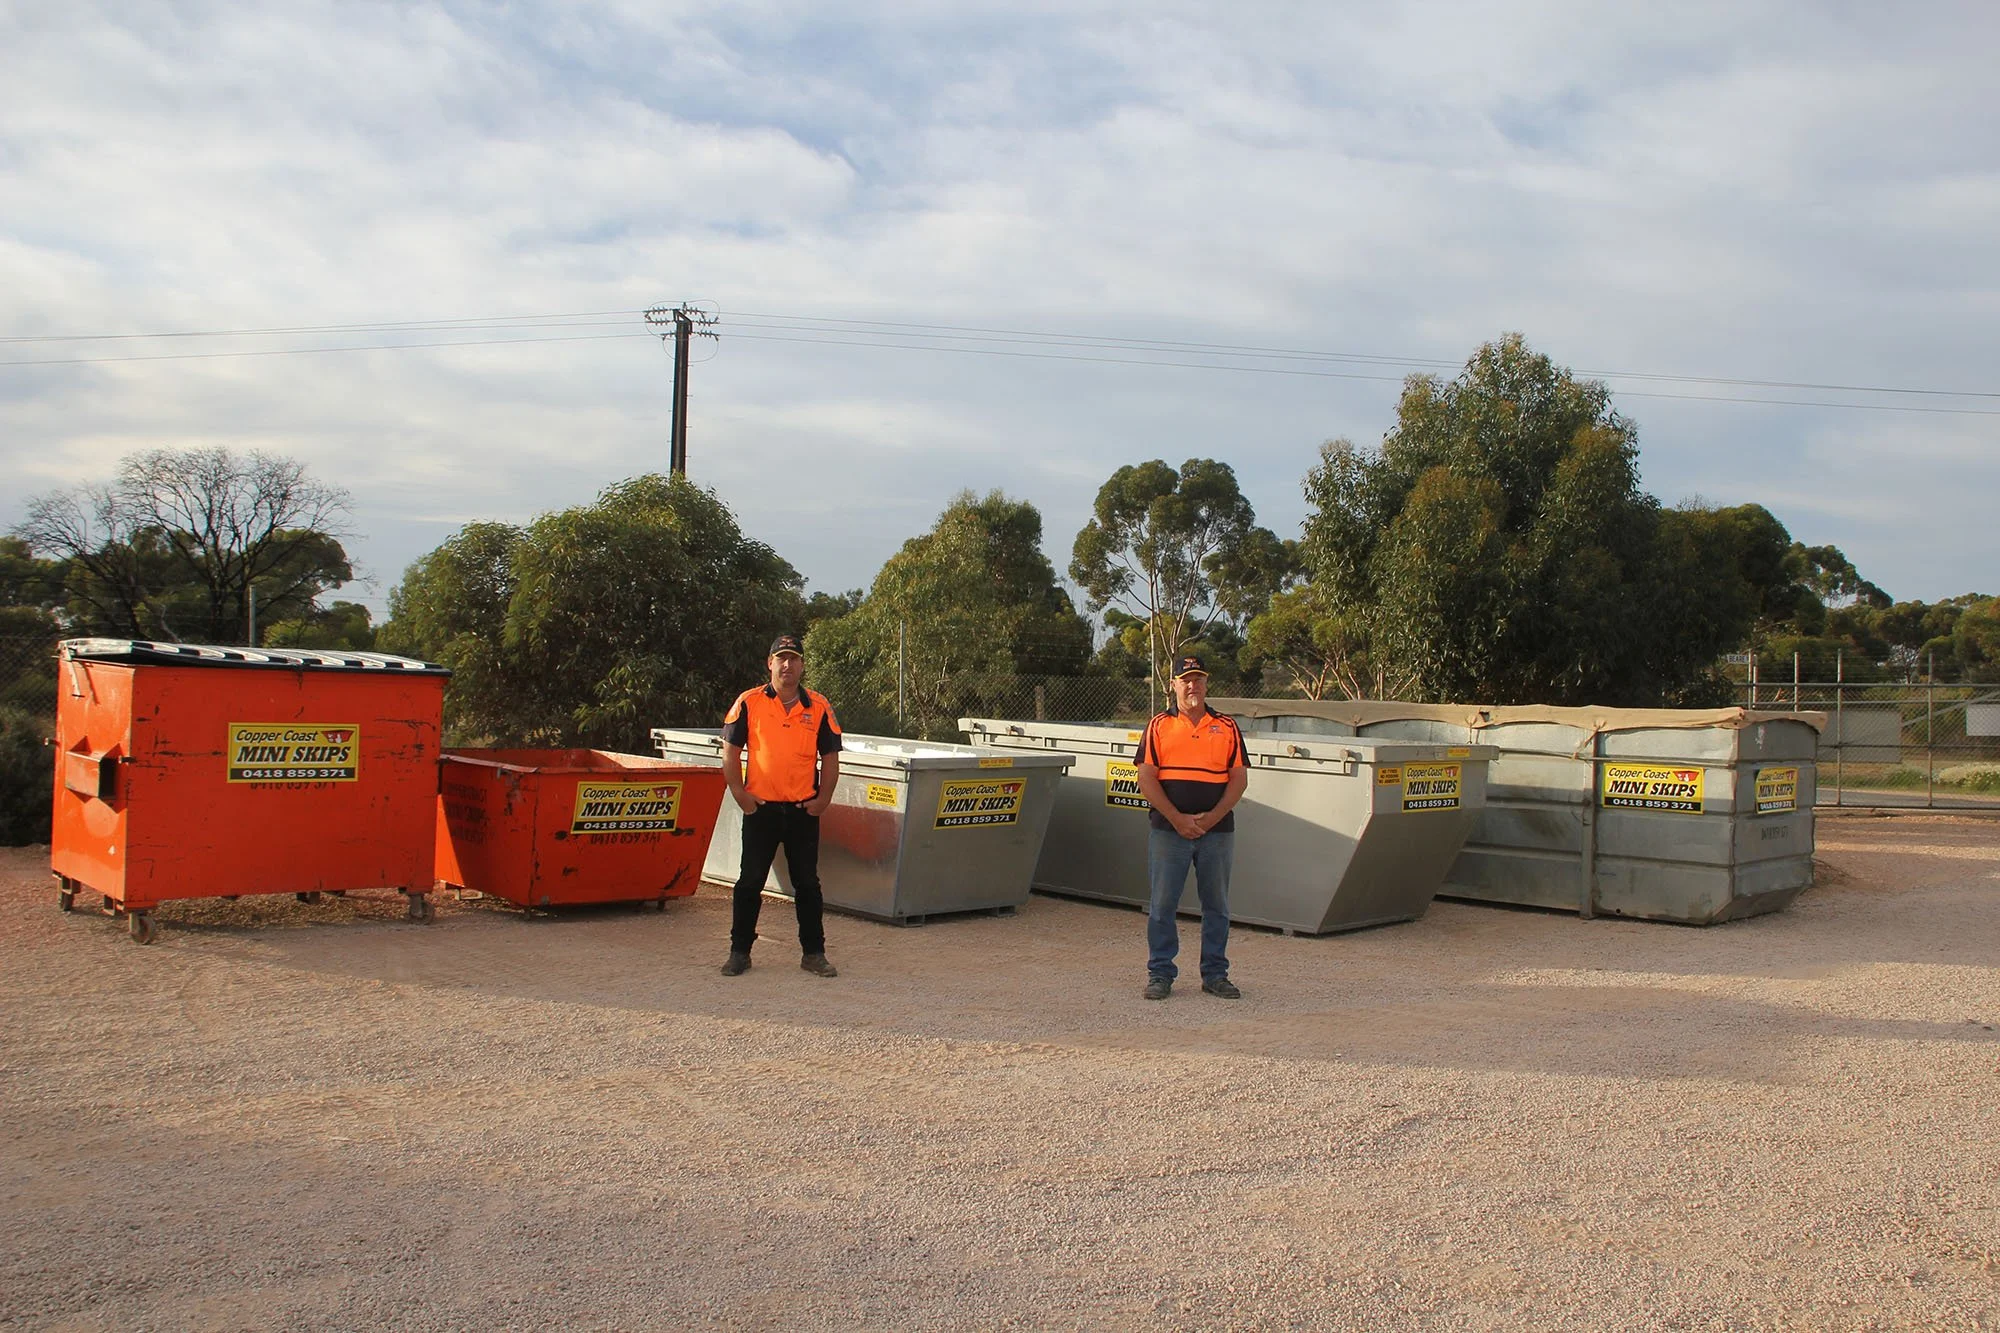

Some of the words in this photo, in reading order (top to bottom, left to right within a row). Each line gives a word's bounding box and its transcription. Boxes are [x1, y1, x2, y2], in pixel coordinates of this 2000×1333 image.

[236, 730, 281, 743] Copper
[283, 730, 318, 741] Coast
[237, 746, 290, 762] MINI
[292, 746, 351, 762] SKIPS
[242, 769, 283, 778] 0418
[287, 769, 316, 778] 859
[320, 769, 347, 777] 371
[1110, 766, 1138, 777] Copper
[1407, 768, 1427, 780] Copper
[1428, 767, 1443, 777] Coast
[1608, 768, 1641, 779] Copper
[1643, 769, 1670, 780] Coast
[582, 788, 620, 800] Copper
[621, 788, 650, 798] Coast
[946, 785, 975, 798] Copper
[976, 784, 1000, 795] Coast
[1407, 781, 1430, 796] MINI
[1432, 780, 1457, 794] SKIPS
[1609, 780, 1648, 795] MINI
[1650, 782, 1697, 797] SKIPS
[943, 798, 979, 813] MINI
[977, 796, 1018, 811] SKIPS
[1114, 797, 1139, 806] 0418
[1613, 798, 1643, 806] 0418
[1645, 800, 1669, 808] 859
[1671, 801, 1694, 810] 371
[580, 802, 626, 817] MINI
[625, 801, 674, 816] SKIPS
[583, 822, 617, 830] 0418
[944, 817, 971, 826] 0418
[972, 816, 992, 824] 859
